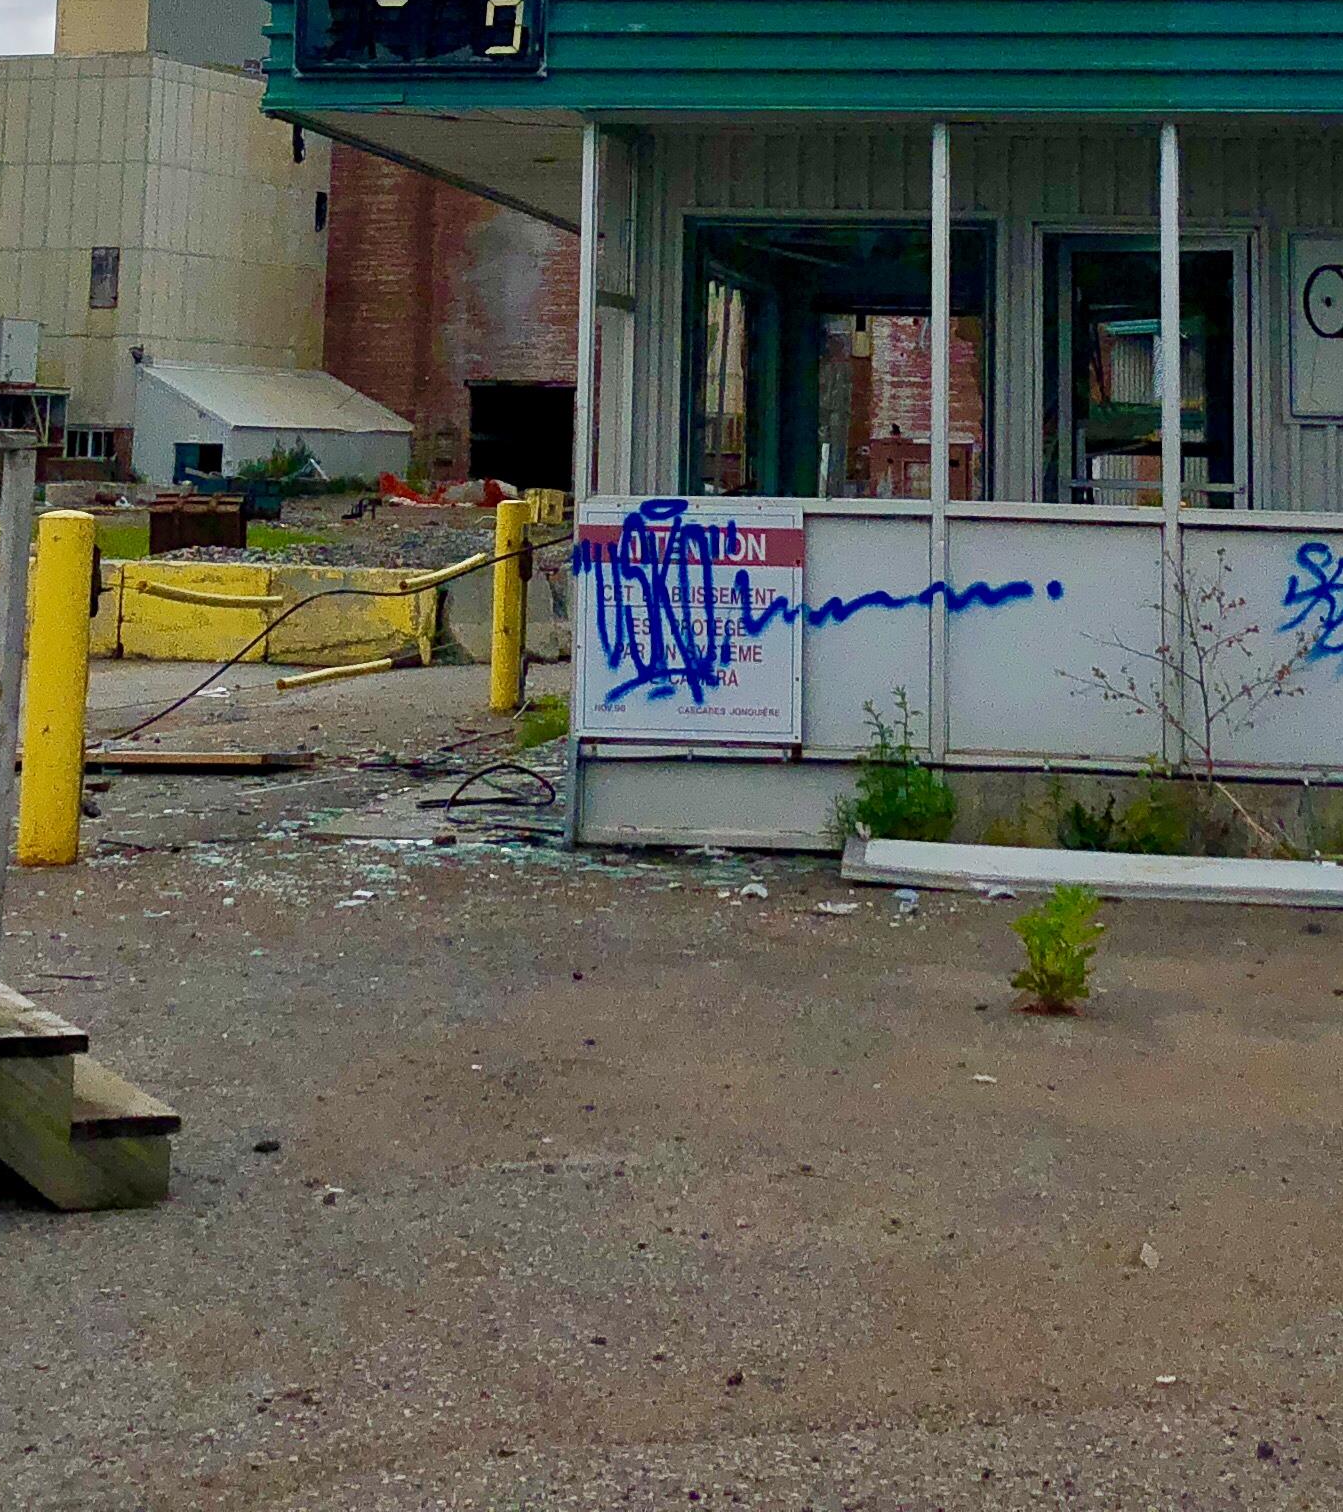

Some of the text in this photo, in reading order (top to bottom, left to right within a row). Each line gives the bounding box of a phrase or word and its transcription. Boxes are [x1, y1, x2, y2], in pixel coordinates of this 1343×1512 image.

[617, 530, 766, 561] ATTENION
[643, 585, 777, 606] BLISSEMENT
[632, 617, 658, 636] ES
